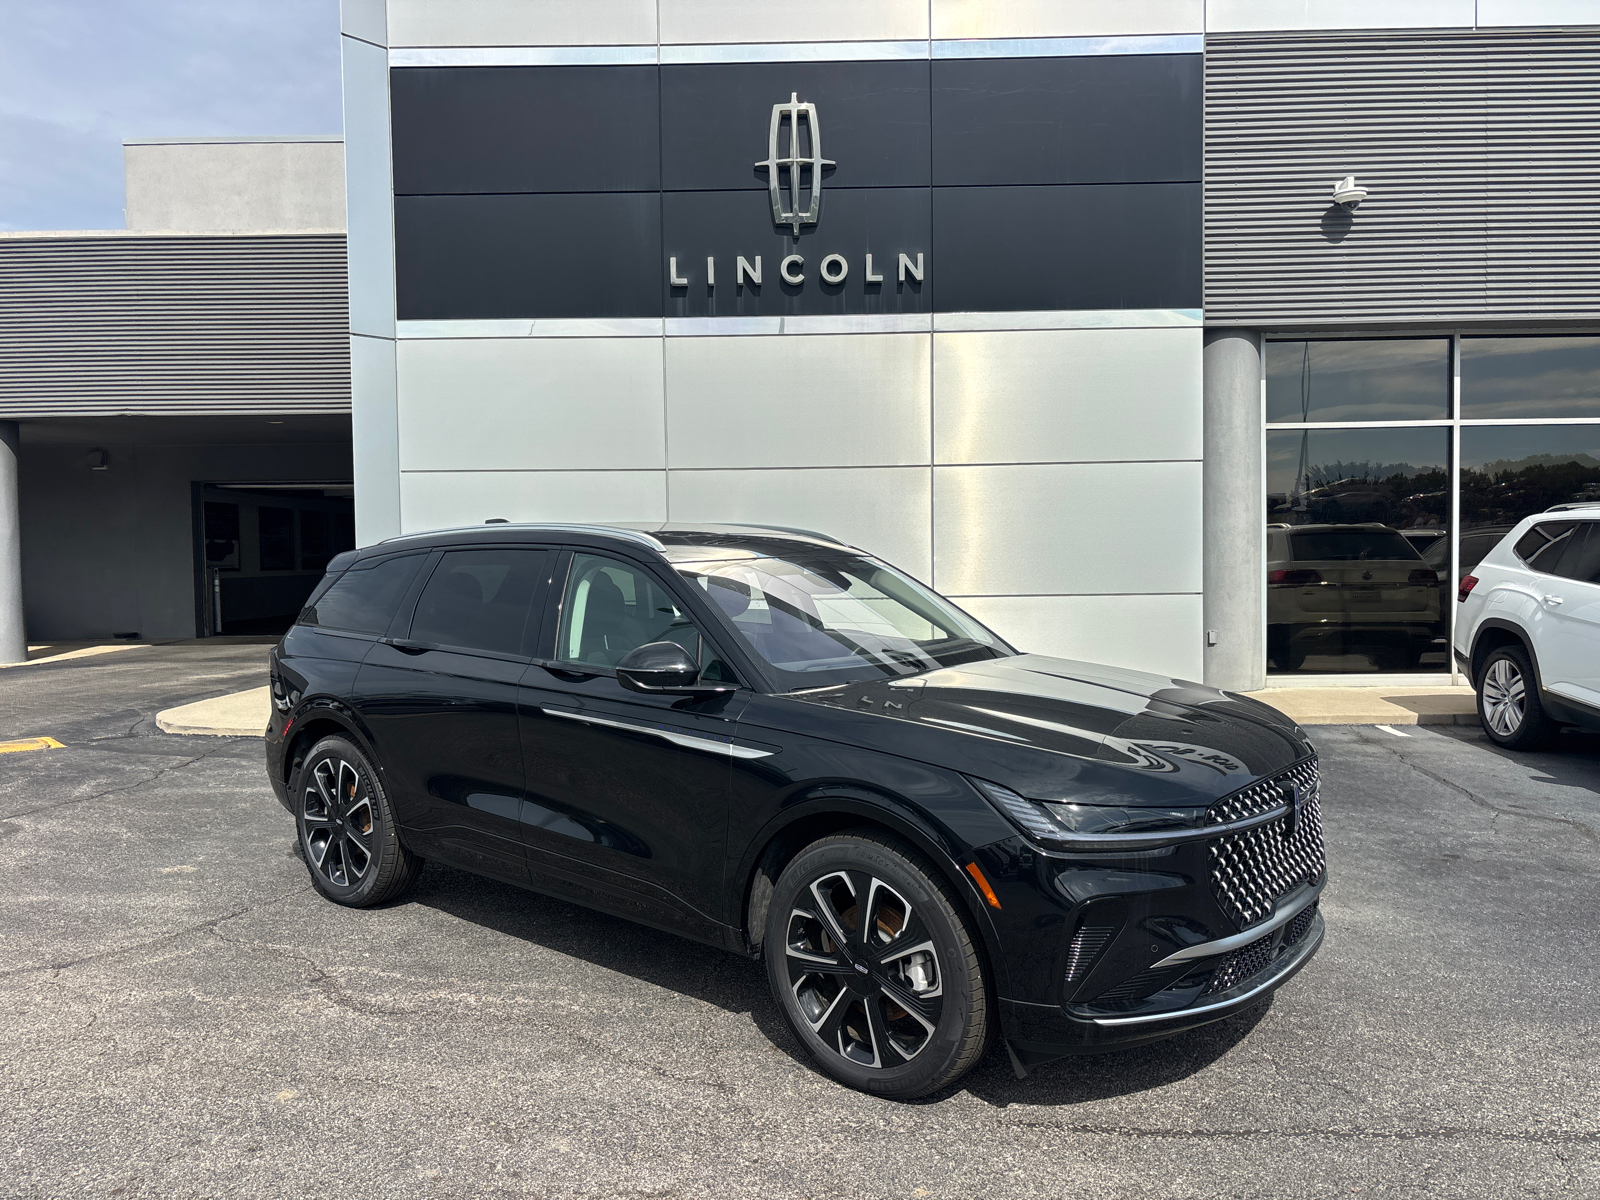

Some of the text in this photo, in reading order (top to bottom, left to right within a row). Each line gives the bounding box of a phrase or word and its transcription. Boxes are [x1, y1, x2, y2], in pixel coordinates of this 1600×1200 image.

[669, 253, 924, 286] LINCOLN
[658, 724, 729, 742] NAUTILUS
[358, 767, 380, 820] MICHELIN
[789, 848, 845, 885] MICHELIN
[855, 849, 889, 868] PRIMACY
[869, 1061, 934, 1092] MICHELIN
